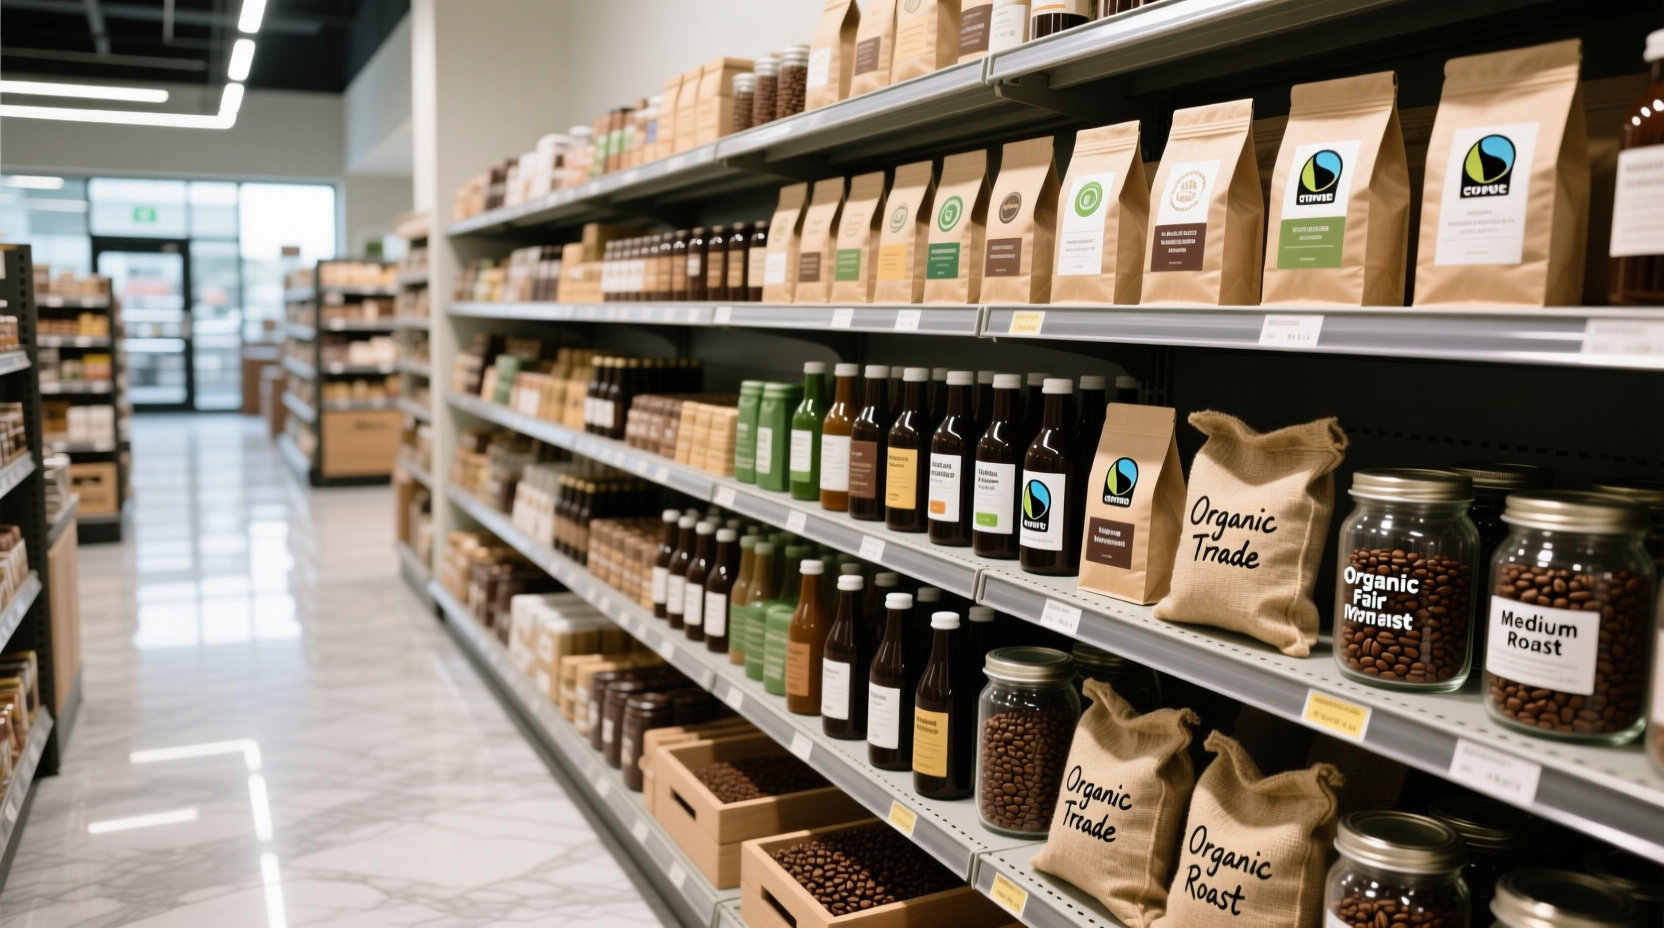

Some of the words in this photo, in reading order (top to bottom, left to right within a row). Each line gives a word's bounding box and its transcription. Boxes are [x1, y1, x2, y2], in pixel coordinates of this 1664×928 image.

[1190, 495, 1278, 542] Organic
[1344, 566, 1419, 594] Organic
[1353, 588, 1387, 610] Fair
[1501, 609, 1578, 639] Medium
[1507, 631, 1562, 657] Roast
[1066, 765, 1133, 811] Organic
[1189, 825, 1273, 881] Organic
[1185, 864, 1246, 916] Roast
